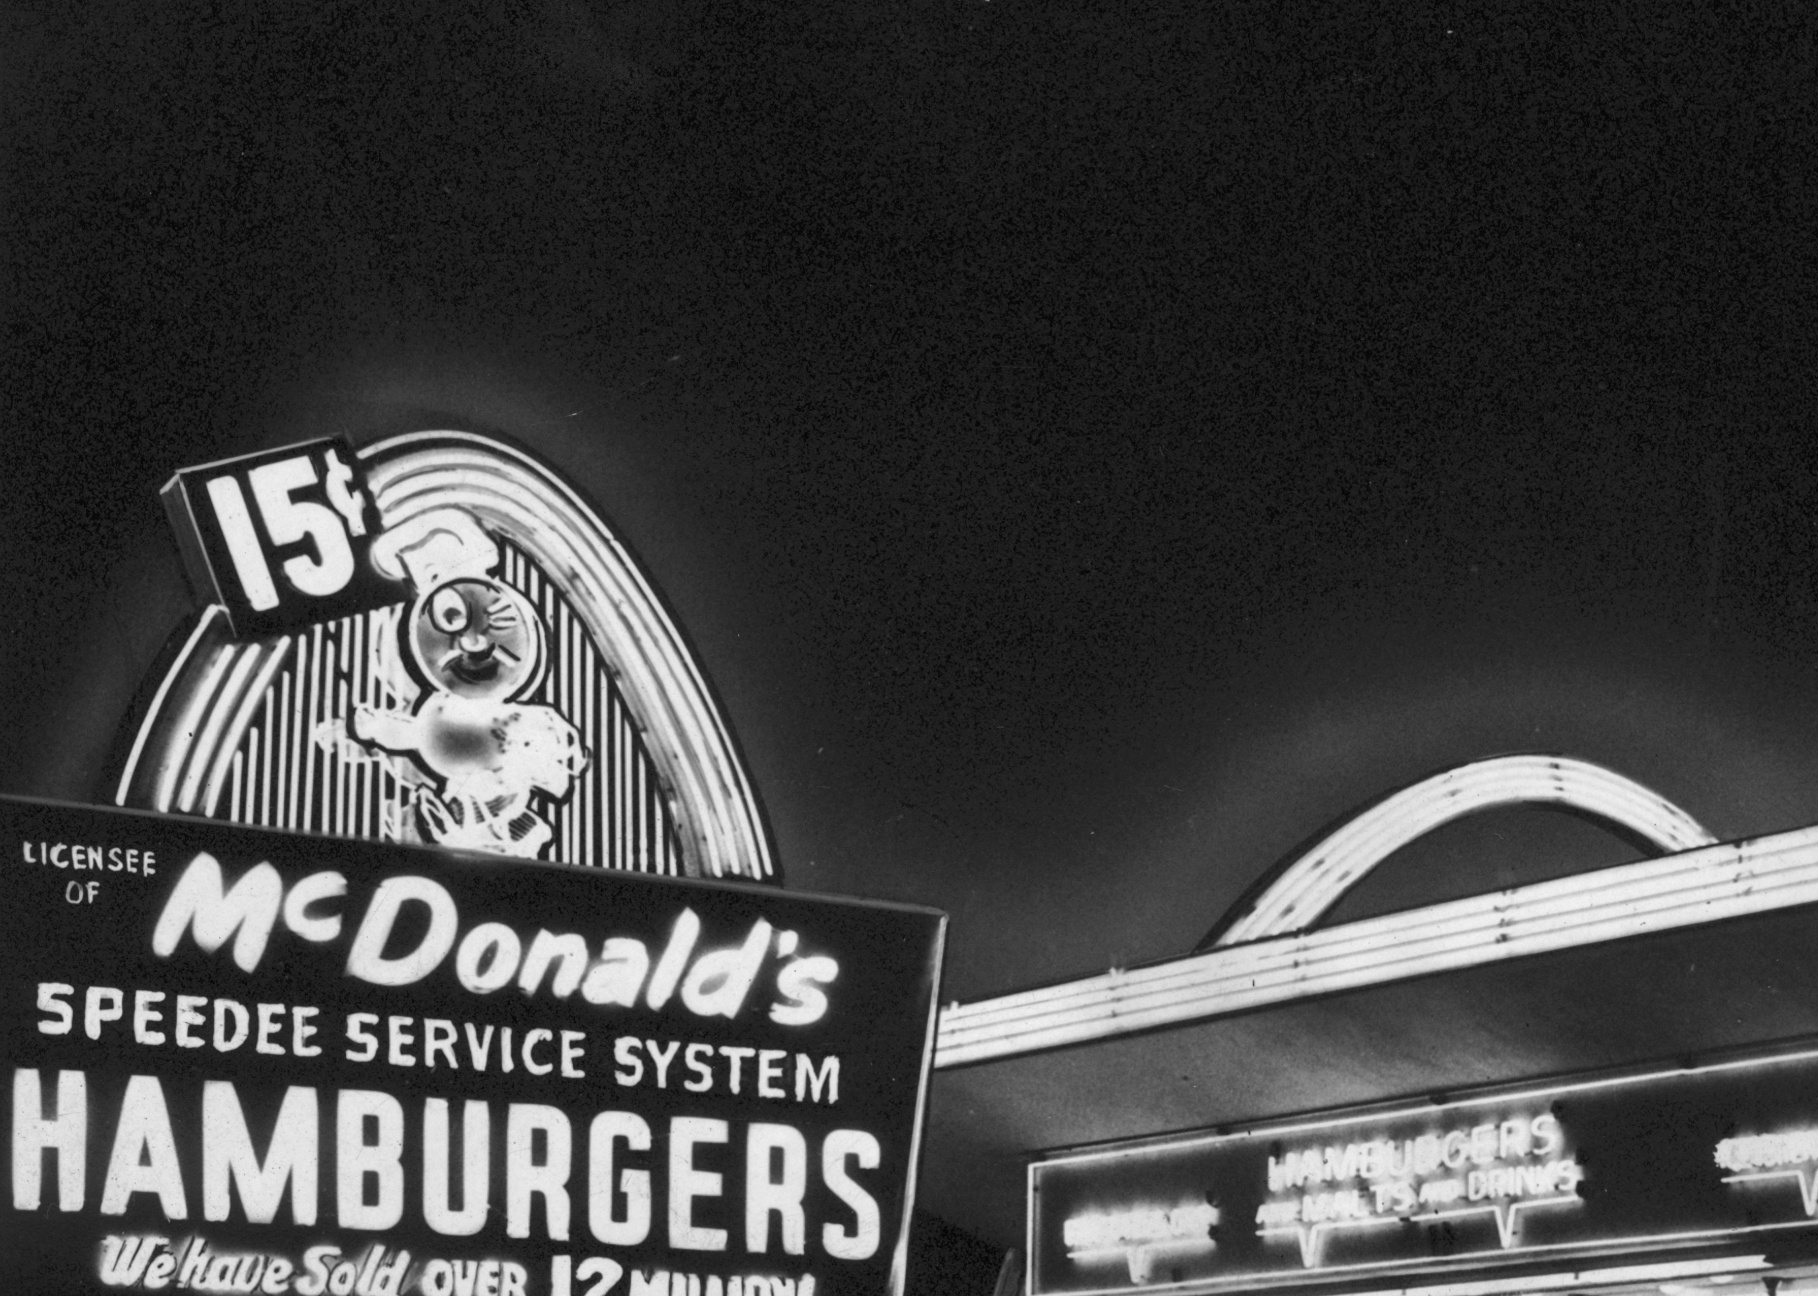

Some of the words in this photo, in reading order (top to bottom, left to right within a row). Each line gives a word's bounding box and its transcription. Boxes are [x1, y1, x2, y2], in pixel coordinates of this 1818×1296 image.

[206, 448, 367, 612] 15¢
[23, 841, 156, 877] LICENSEE
[65, 879, 101, 904] OF
[152, 850, 841, 1027] McDonald's
[37, 982, 322, 1057] SPEEDEE
[345, 1010, 588, 1080] SERVICE
[613, 1037, 841, 1105] SYSTEM
[11, 1066, 883, 1261] HAMBURGERS
[100, 1234, 179, 1290] We
[176, 1235, 296, 1296] have
